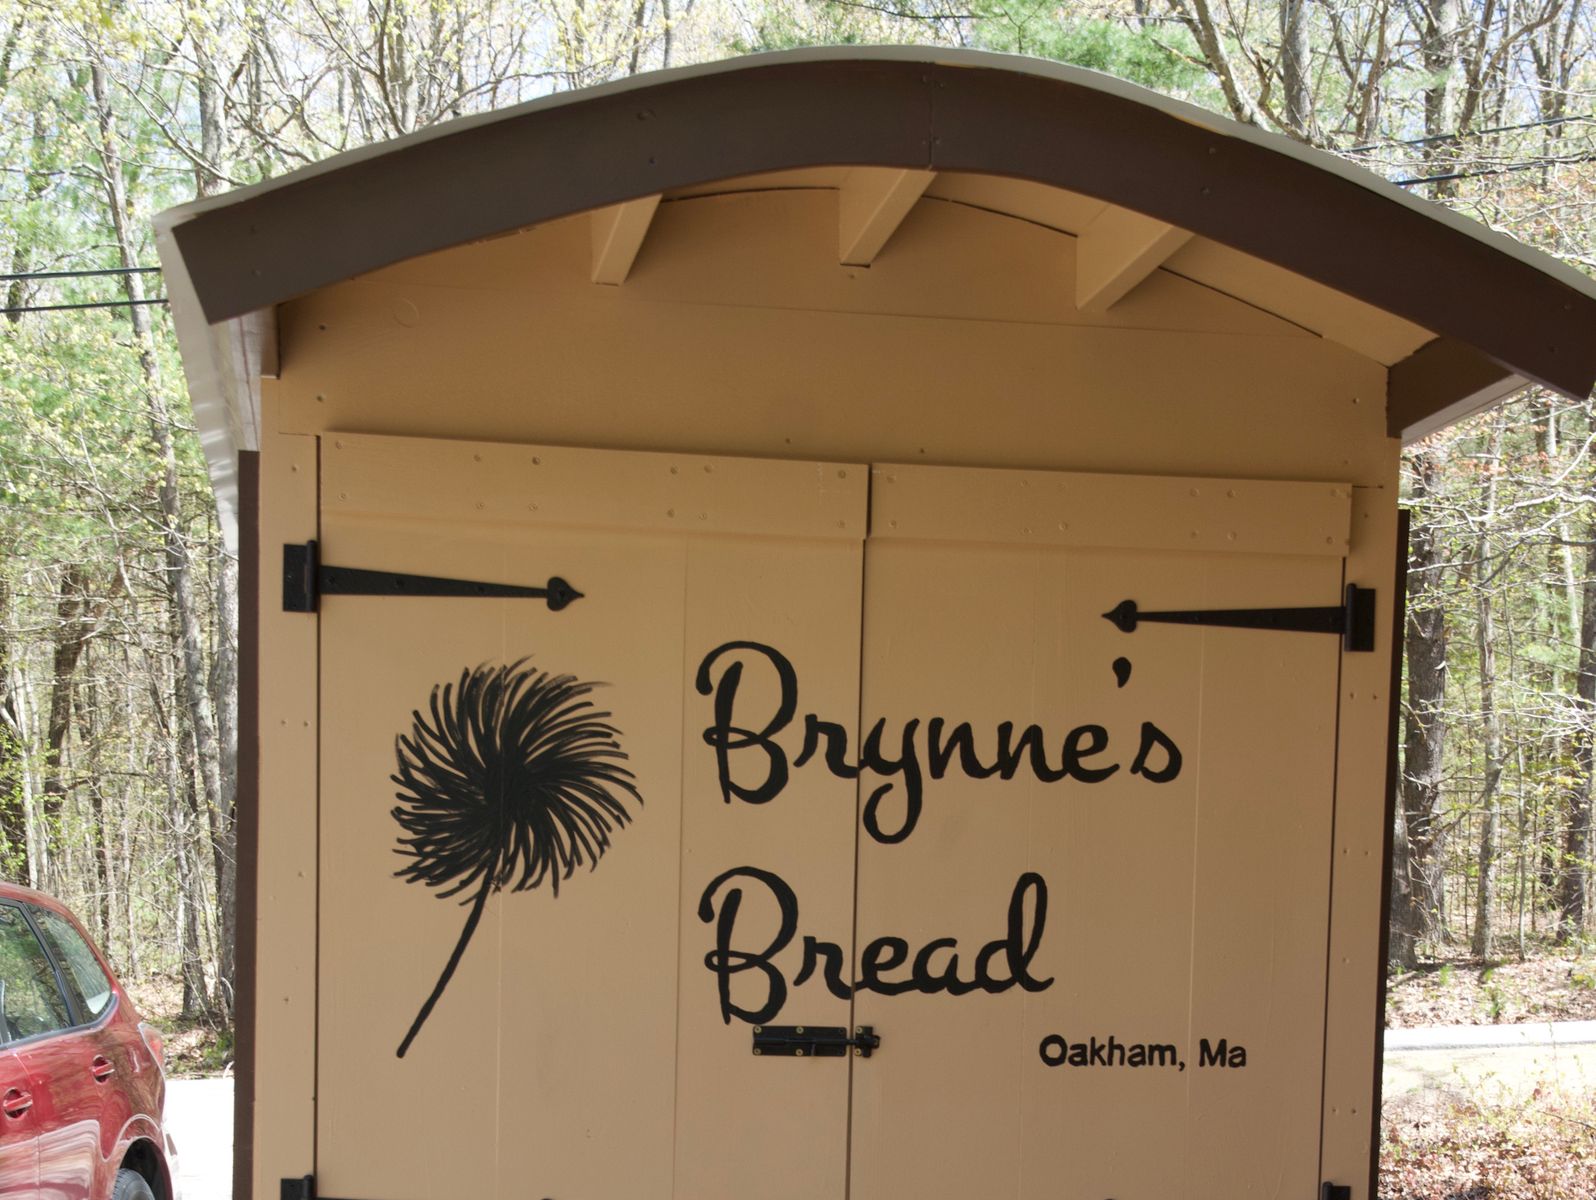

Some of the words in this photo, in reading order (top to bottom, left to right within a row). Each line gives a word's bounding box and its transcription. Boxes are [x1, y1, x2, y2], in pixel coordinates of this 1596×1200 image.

[695, 640, 1183, 844] Brynne's
[697, 866, 1055, 1025] Bread
[1039, 1034, 1186, 1072] Oakham,
[1199, 1038, 1247, 1068] Ma
